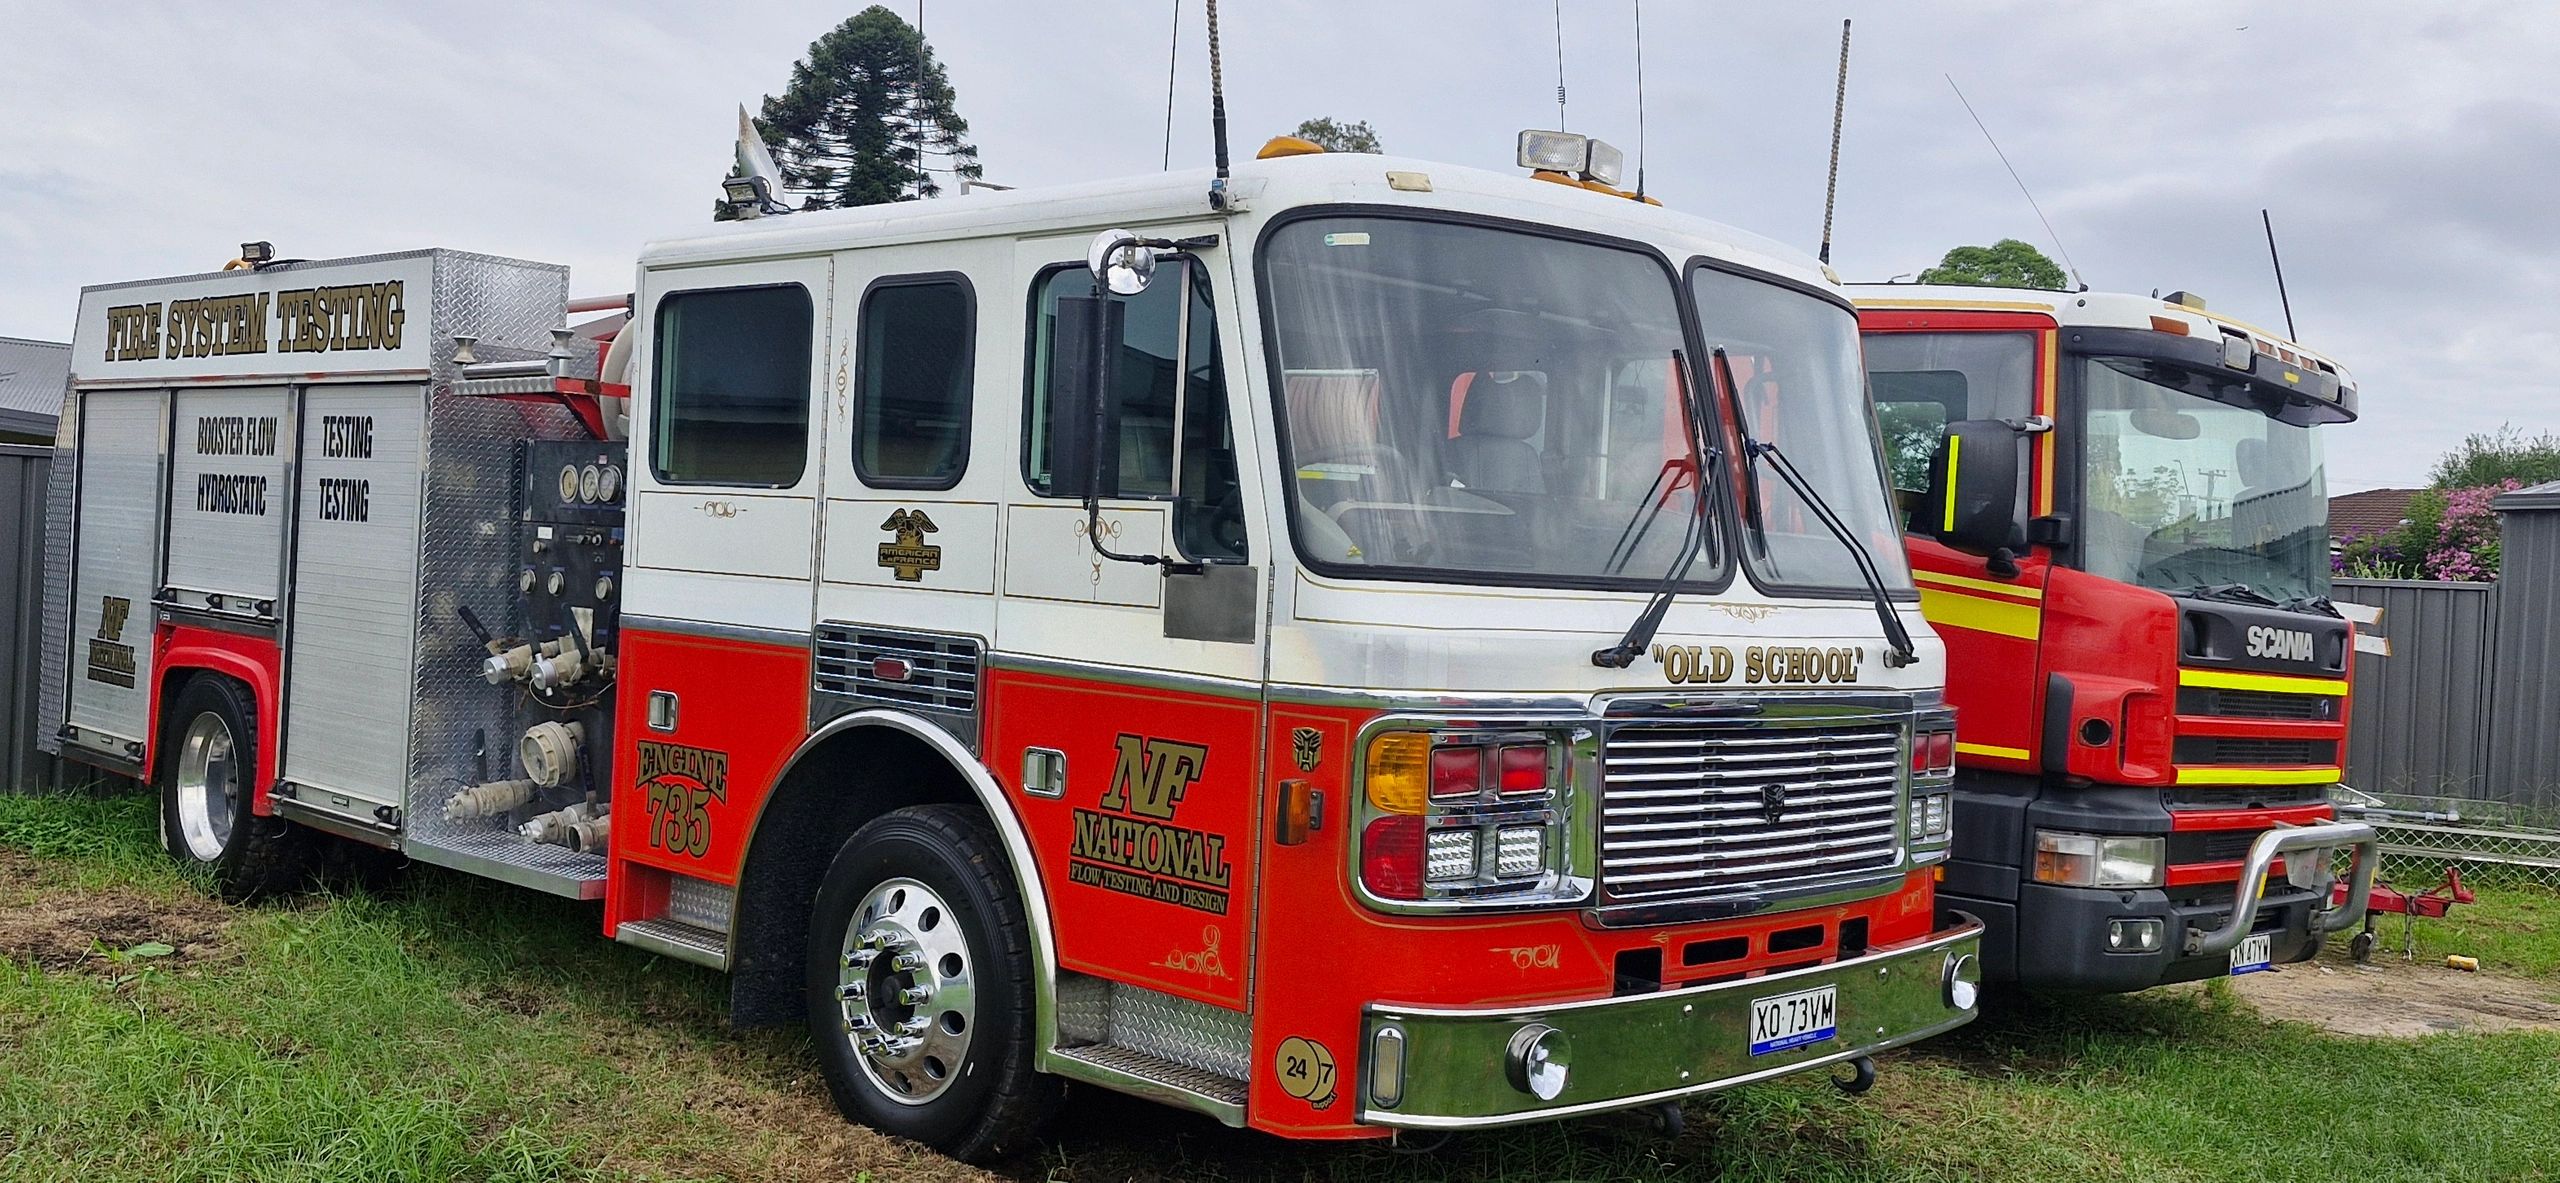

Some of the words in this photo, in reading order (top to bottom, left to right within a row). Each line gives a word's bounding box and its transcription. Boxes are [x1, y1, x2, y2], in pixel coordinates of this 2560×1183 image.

[105, 302, 162, 362] FIRE
[166, 292, 270, 360] SYSTEM
[277, 280, 405, 353] TESTING
[197, 416, 244, 455] BOOSTER
[246, 417, 277, 456] FLOW
[323, 416, 373, 458] TESTING
[197, 473, 267, 516] HYDROSTATIC
[319, 478, 369, 522] TESTING
[1652, 643, 1734, 684] "OLD
[1745, 645, 1864, 684] SCHOOL"
[2246, 625, 2314, 662] SCANIA
[636, 740, 729, 805] ENGINE
[1100, 733, 1208, 821] NF
[647, 781, 711, 858] 735
[1071, 807, 1231, 889] NATIONAL
[1070, 863, 1101, 884] FLOW
[1104, 870, 1151, 896] TESTING
[1153, 881, 1180, 902] AND
[1182, 887, 1226, 914] DESIGN
[1286, 1055, 1307, 1079] 24
[1321, 1062, 1334, 1084] 7
